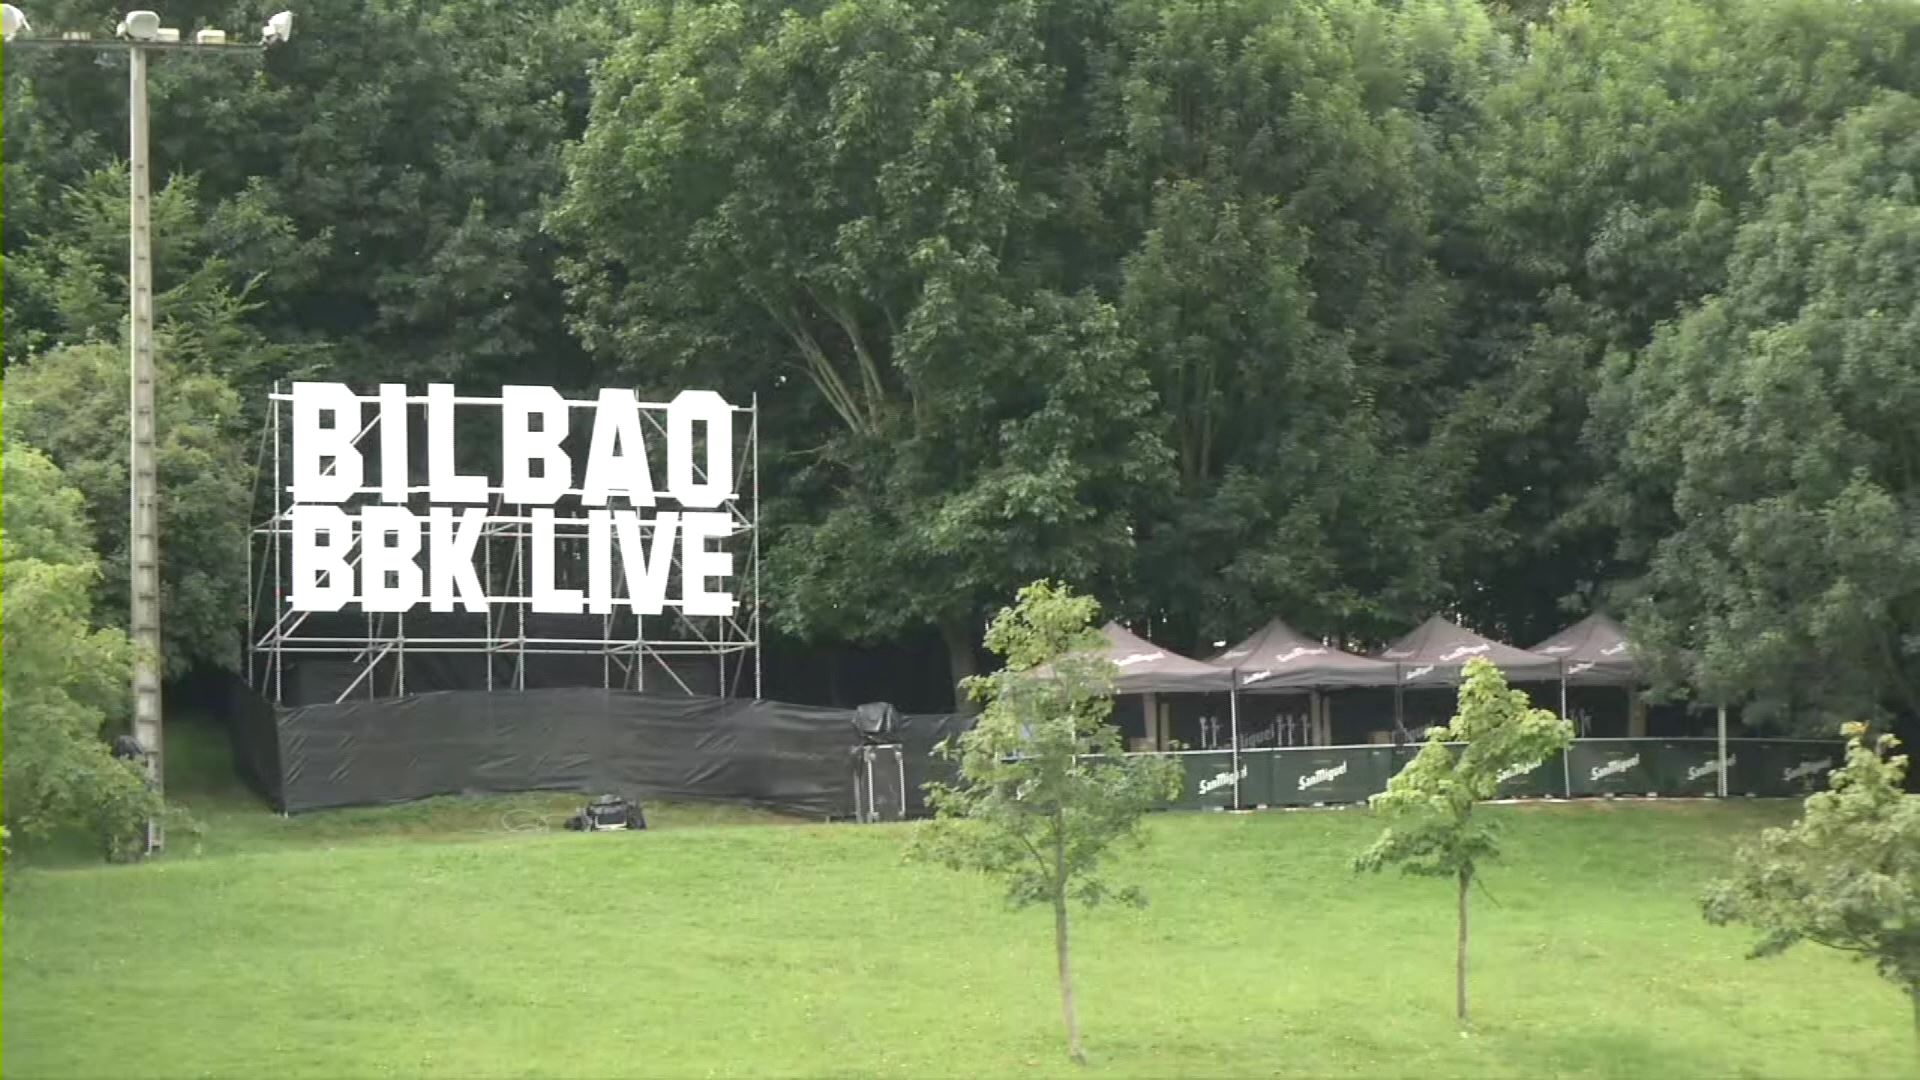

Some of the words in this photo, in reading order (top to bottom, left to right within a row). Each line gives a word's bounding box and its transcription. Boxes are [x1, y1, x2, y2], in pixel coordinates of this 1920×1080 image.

[292, 381, 734, 508] BILBAO
[292, 505, 490, 613] BBK
[531, 507, 734, 617] LIVE
